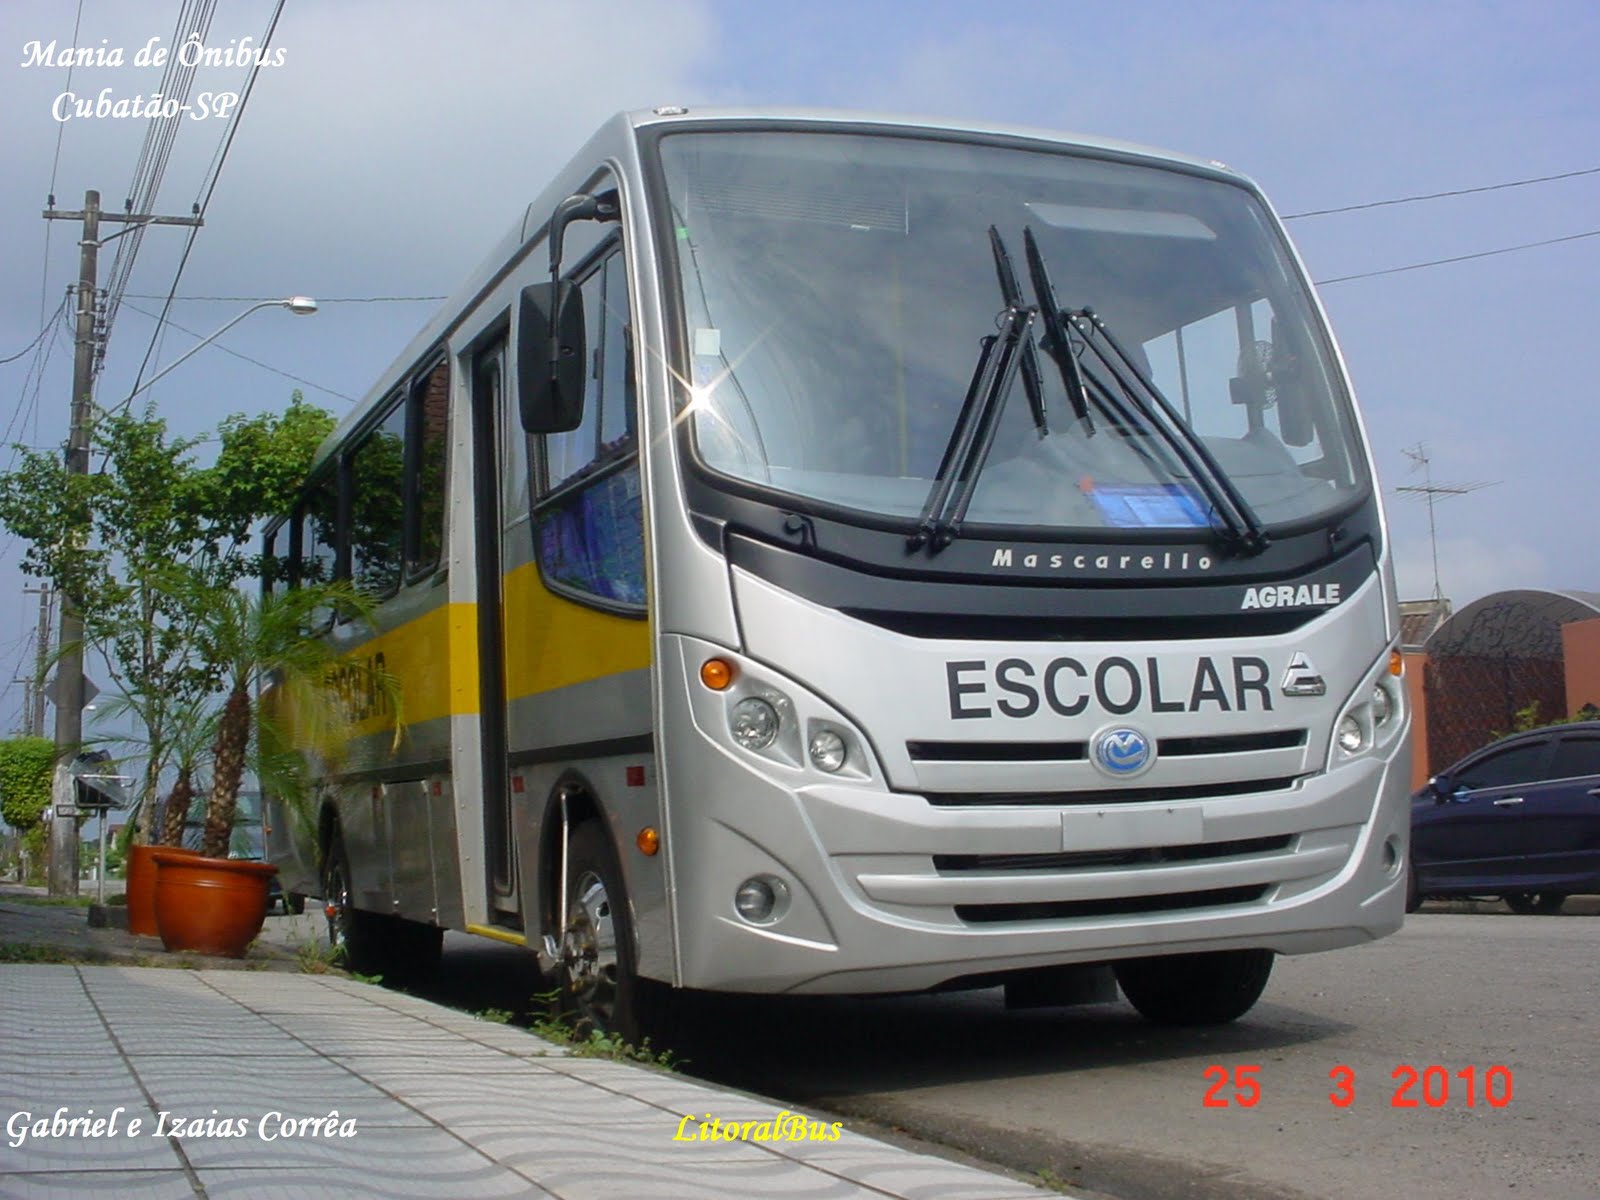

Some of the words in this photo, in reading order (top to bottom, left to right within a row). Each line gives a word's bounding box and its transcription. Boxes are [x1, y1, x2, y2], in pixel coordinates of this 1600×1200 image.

[992, 548, 1212, 571] Mascarello
[1241, 583, 1341, 610] AGRALE
[945, 656, 1274, 720] ESCOLAR
